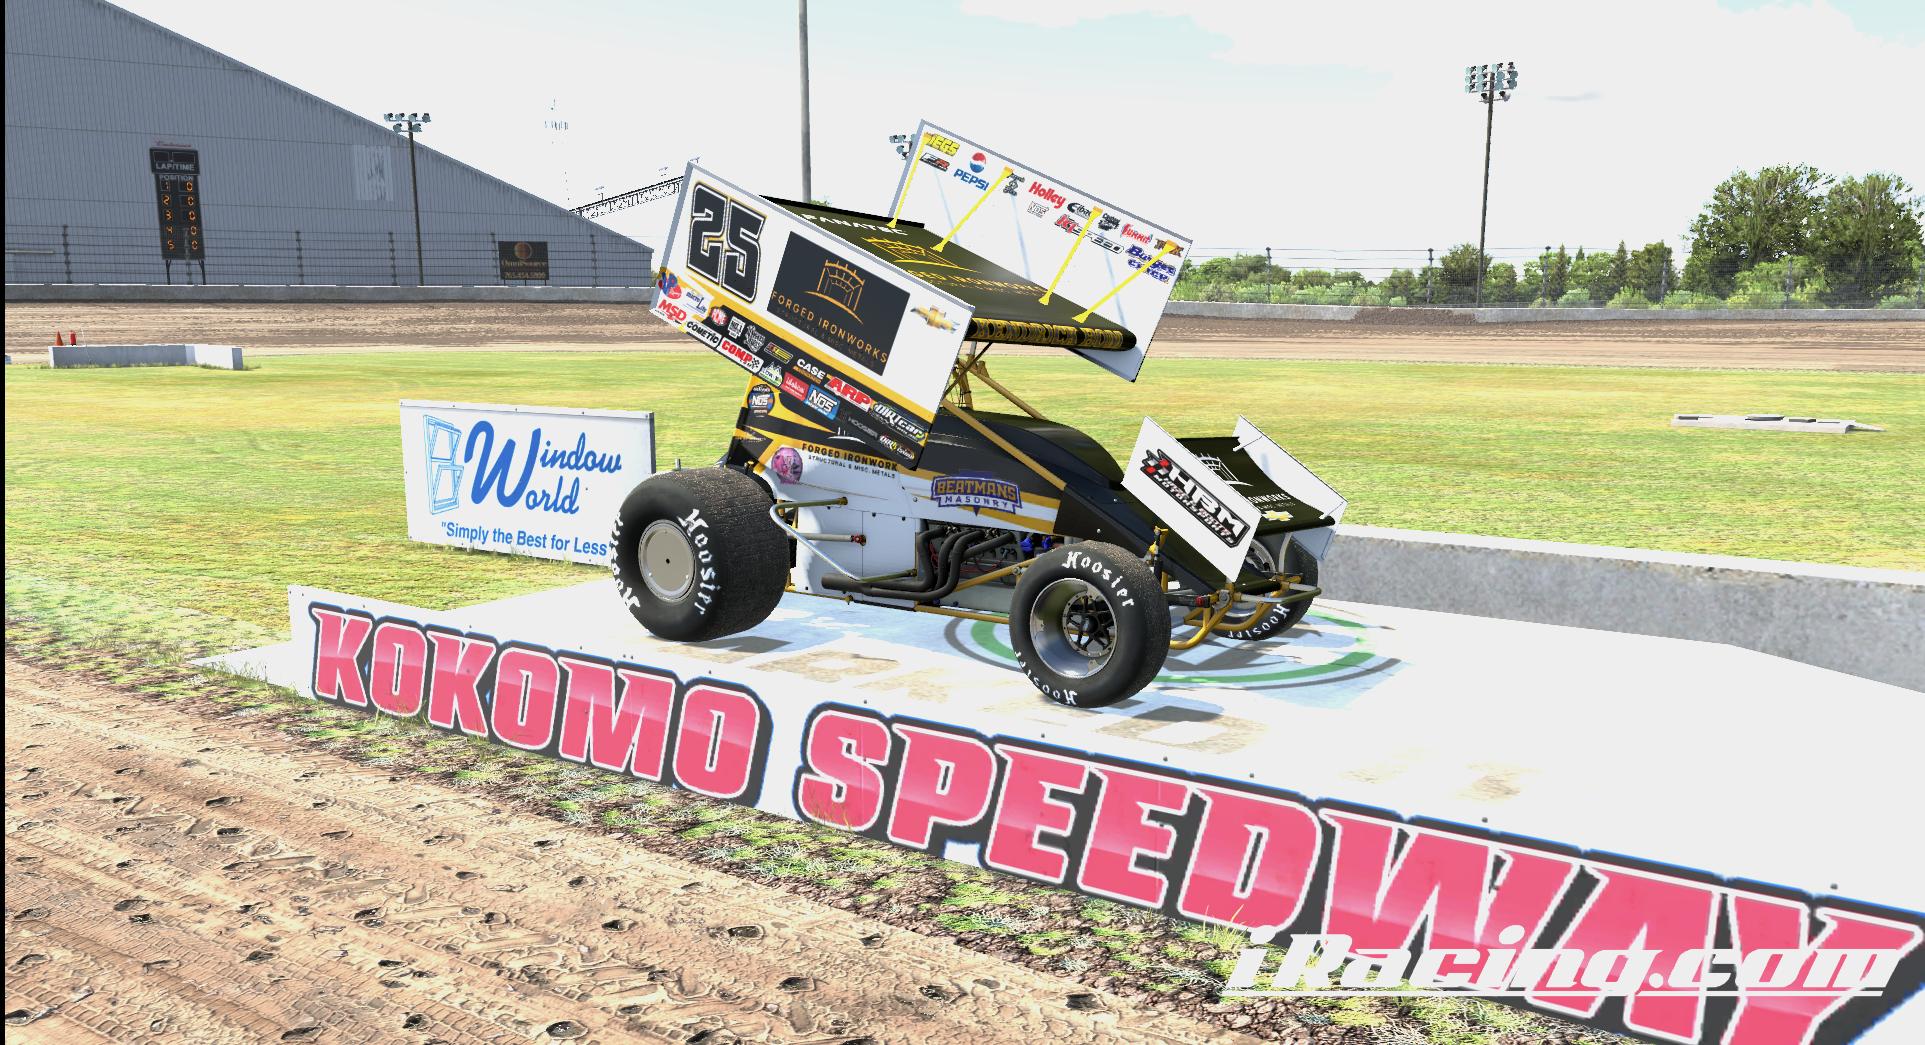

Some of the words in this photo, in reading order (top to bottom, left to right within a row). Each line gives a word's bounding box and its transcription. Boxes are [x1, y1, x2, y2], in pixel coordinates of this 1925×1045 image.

[953, 168, 990, 191] PEPSI
[1028, 181, 1066, 209] Holley
[686, 182, 767, 304] 25
[658, 299, 687, 321] MSD
[771, 290, 815, 321] FORGED
[818, 317, 888, 363] IRONWORKS
[721, 340, 753, 364] COMP
[796, 358, 827, 380] CASE
[751, 394, 770, 406] NOS
[808, 389, 838, 413] NOS
[826, 376, 872, 406] ARP
[464, 420, 622, 508] Window
[801, 443, 840, 459] FORGED
[843, 452, 898, 472] IRONWORK
[808, 455, 846, 469] STRUCTURAL
[871, 469, 896, 479] METALS
[936, 479, 1017, 500] BEATMANS
[944, 495, 1009, 508] MASONRY
[1168, 462, 1246, 539] HBM
[441, 521, 489, 545] "Simply
[492, 529, 513, 544] the
[517, 531, 547, 549] Best
[551, 535, 571, 552] for
[677, 508, 721, 615] Hoosier
[1061, 551, 1135, 607] Hoosier
[1227, 603, 1291, 638] Hoosier
[309, 605, 765, 803] KOKOMO
[797, 706, 1925, 1045] SPEEDWAY
